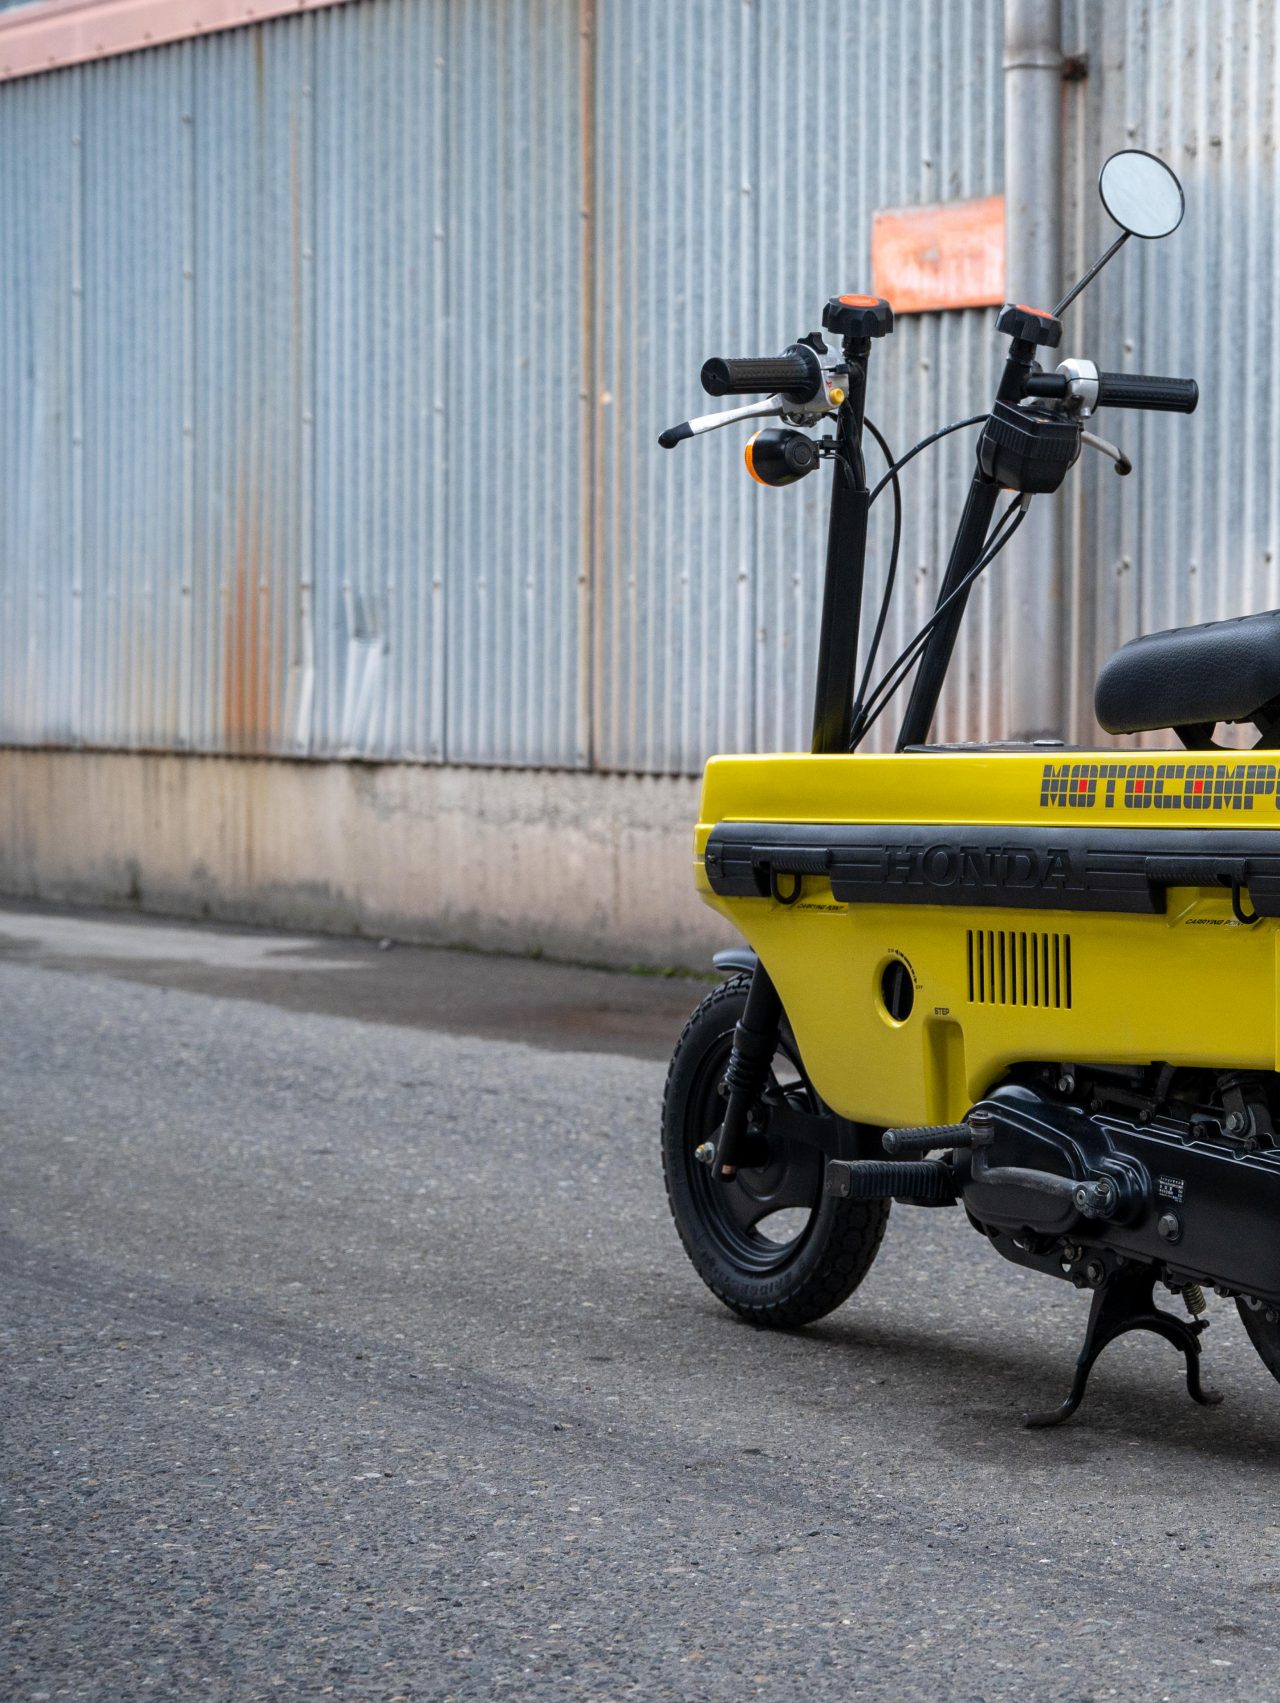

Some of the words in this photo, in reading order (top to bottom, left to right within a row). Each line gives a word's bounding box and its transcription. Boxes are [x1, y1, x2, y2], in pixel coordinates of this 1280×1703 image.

[885, 844, 1085, 890] HONDA
[1185, 918, 1222, 926] CARRYING
[934, 1007, 950, 1015] STEP
